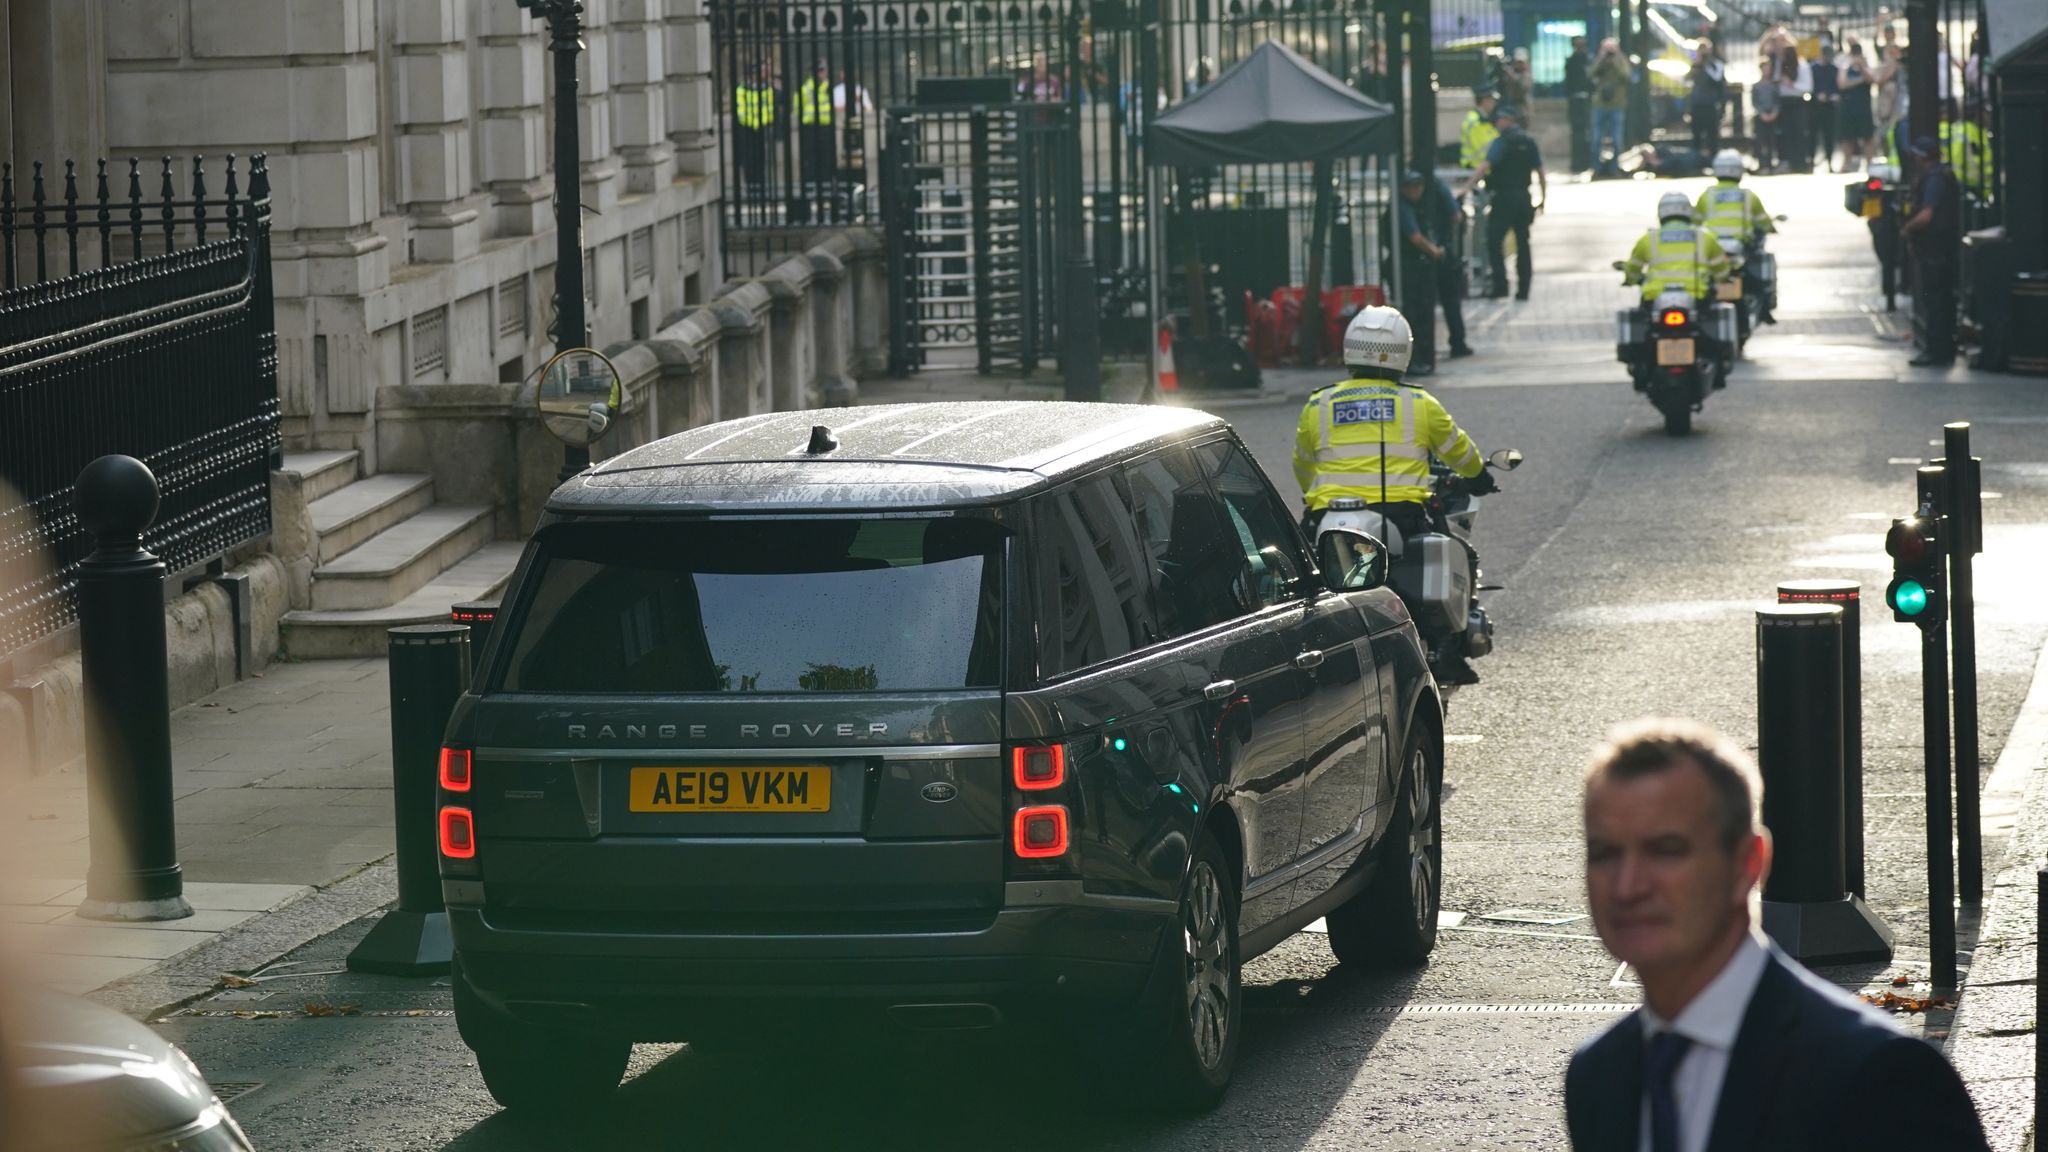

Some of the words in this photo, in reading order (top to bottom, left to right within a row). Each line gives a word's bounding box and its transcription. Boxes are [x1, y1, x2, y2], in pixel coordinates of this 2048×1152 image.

[1335, 407, 1394, 423] POLICE
[567, 724, 707, 738] RANGE
[740, 722, 888, 738] ROVER
[652, 772, 729, 804] AE19
[741, 771, 809, 804] VKM
